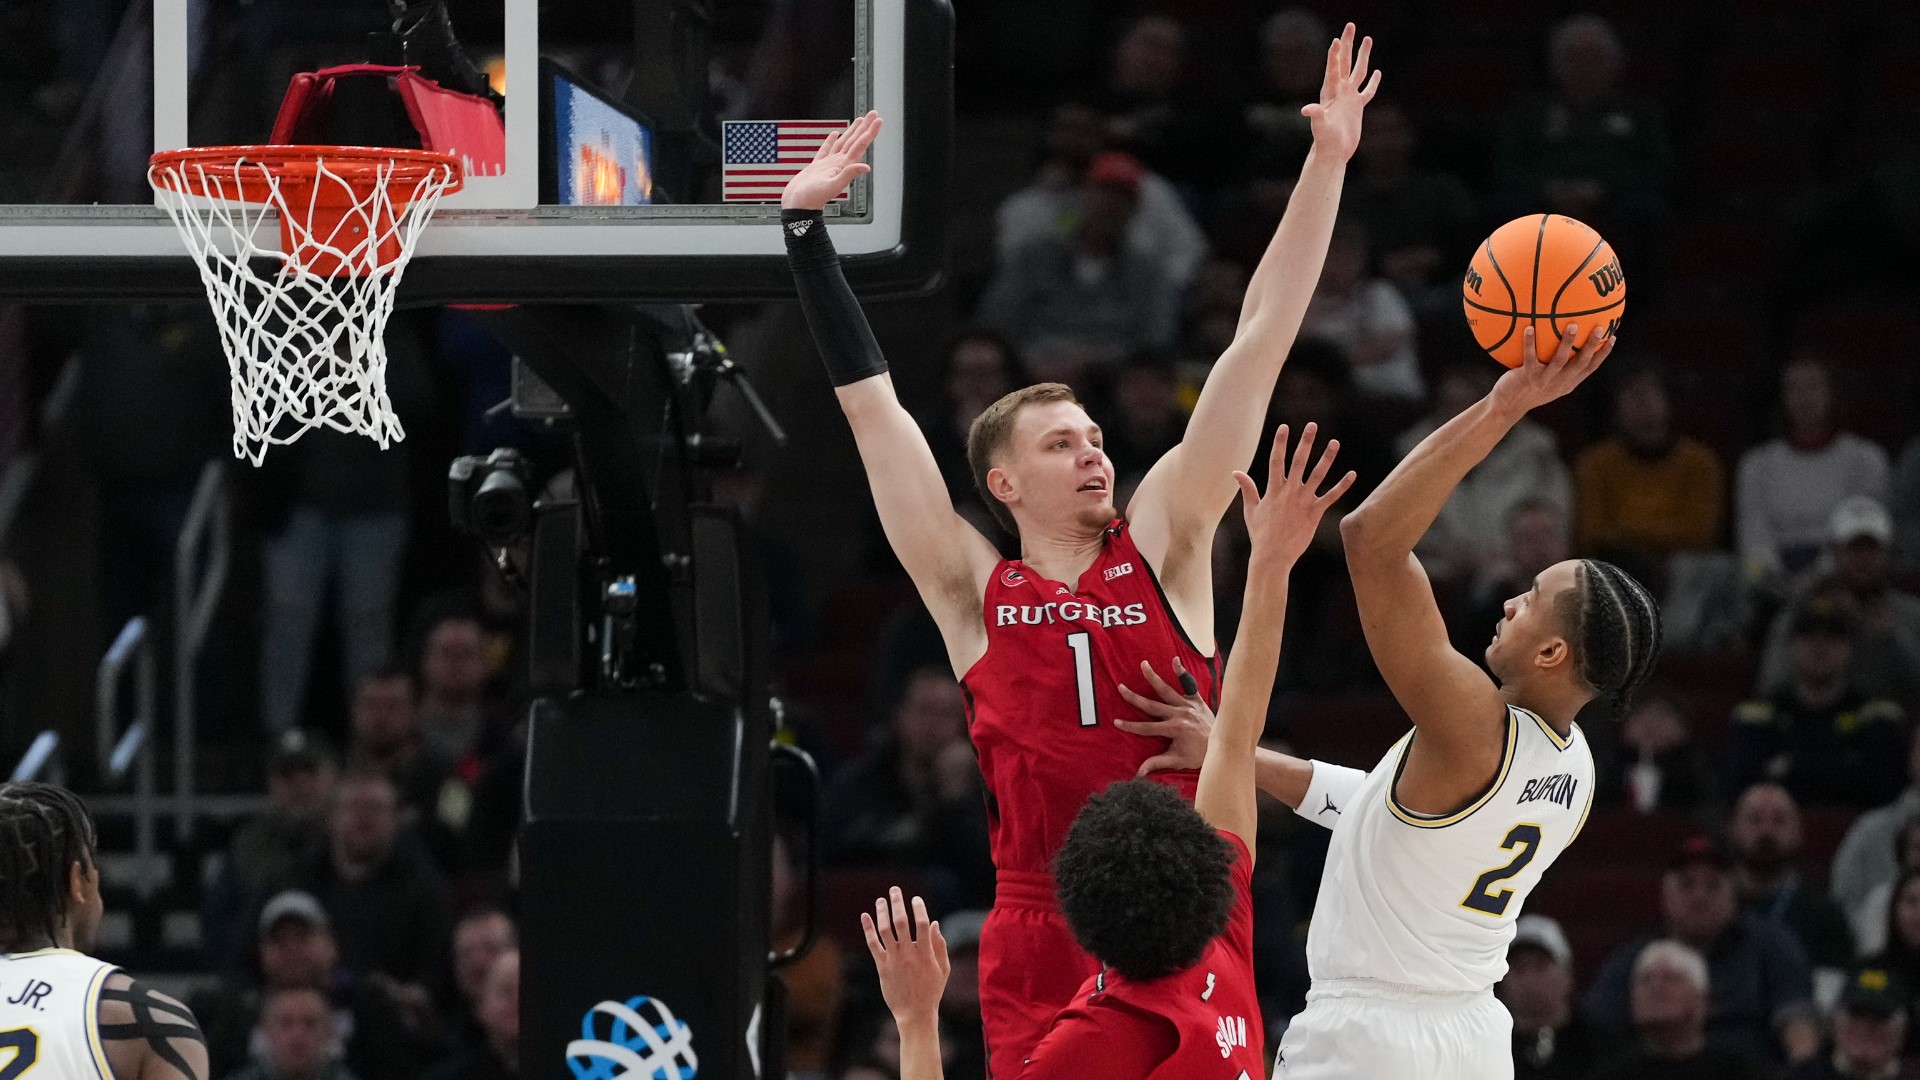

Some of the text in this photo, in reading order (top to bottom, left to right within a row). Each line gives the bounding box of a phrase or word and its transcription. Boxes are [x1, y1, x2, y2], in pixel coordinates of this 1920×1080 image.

[788, 219, 814, 230] adidas
[1588, 255, 1624, 298] Wil
[996, 601, 1147, 628] RUTGERS
[1066, 631, 1097, 727] 1
[1516, 773, 1578, 810] BUFKIN
[1459, 821, 1543, 917] 2
[7, 978, 53, 1012] JR.
